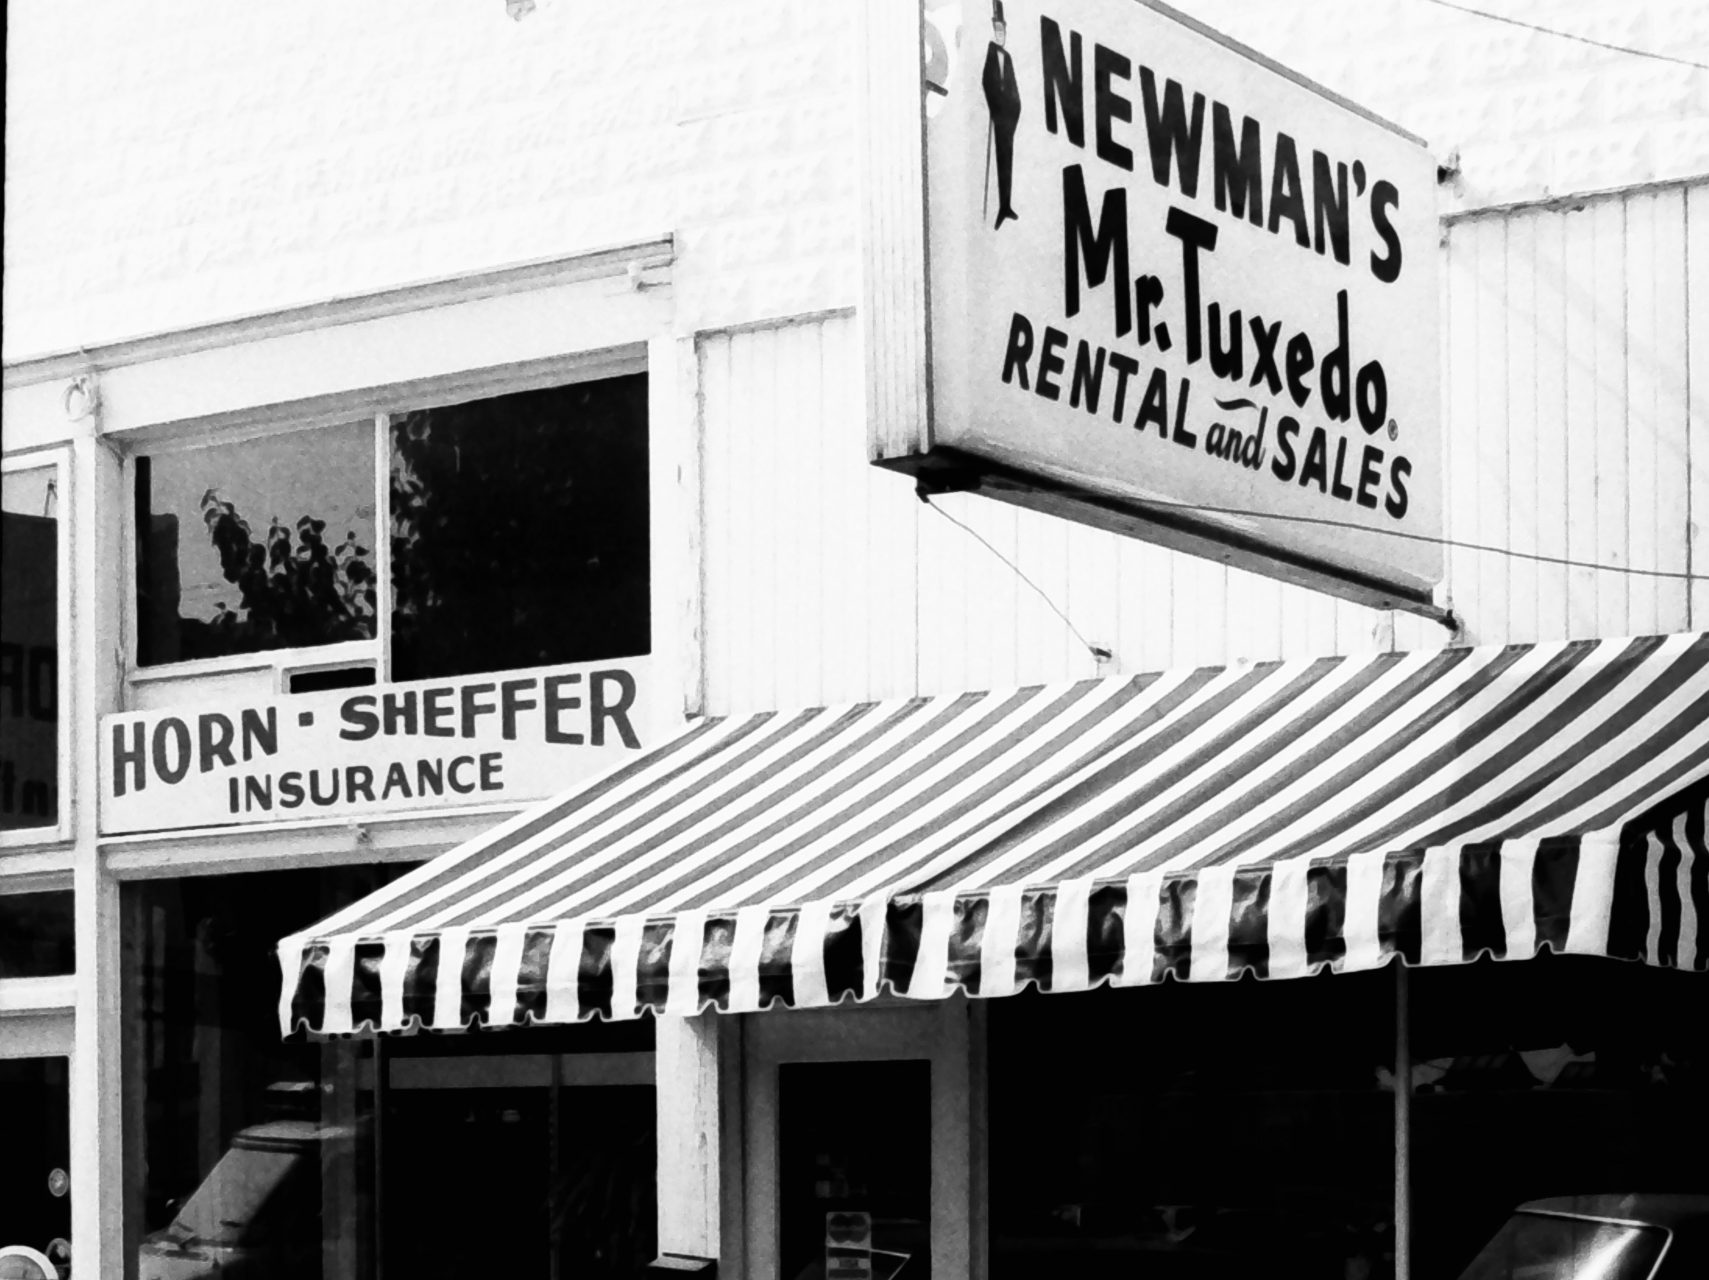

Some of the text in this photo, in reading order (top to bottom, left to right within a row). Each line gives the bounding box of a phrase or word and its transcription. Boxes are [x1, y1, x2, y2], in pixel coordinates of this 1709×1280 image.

[1040, 15, 1402, 283] NEWMAN'S
[1001, 312, 1413, 519] RENTAL and SALES
[112, 705, 279, 798] HORN
[339, 669, 642, 750] SHEFFER
[228, 752, 505, 813] INSURANCE
